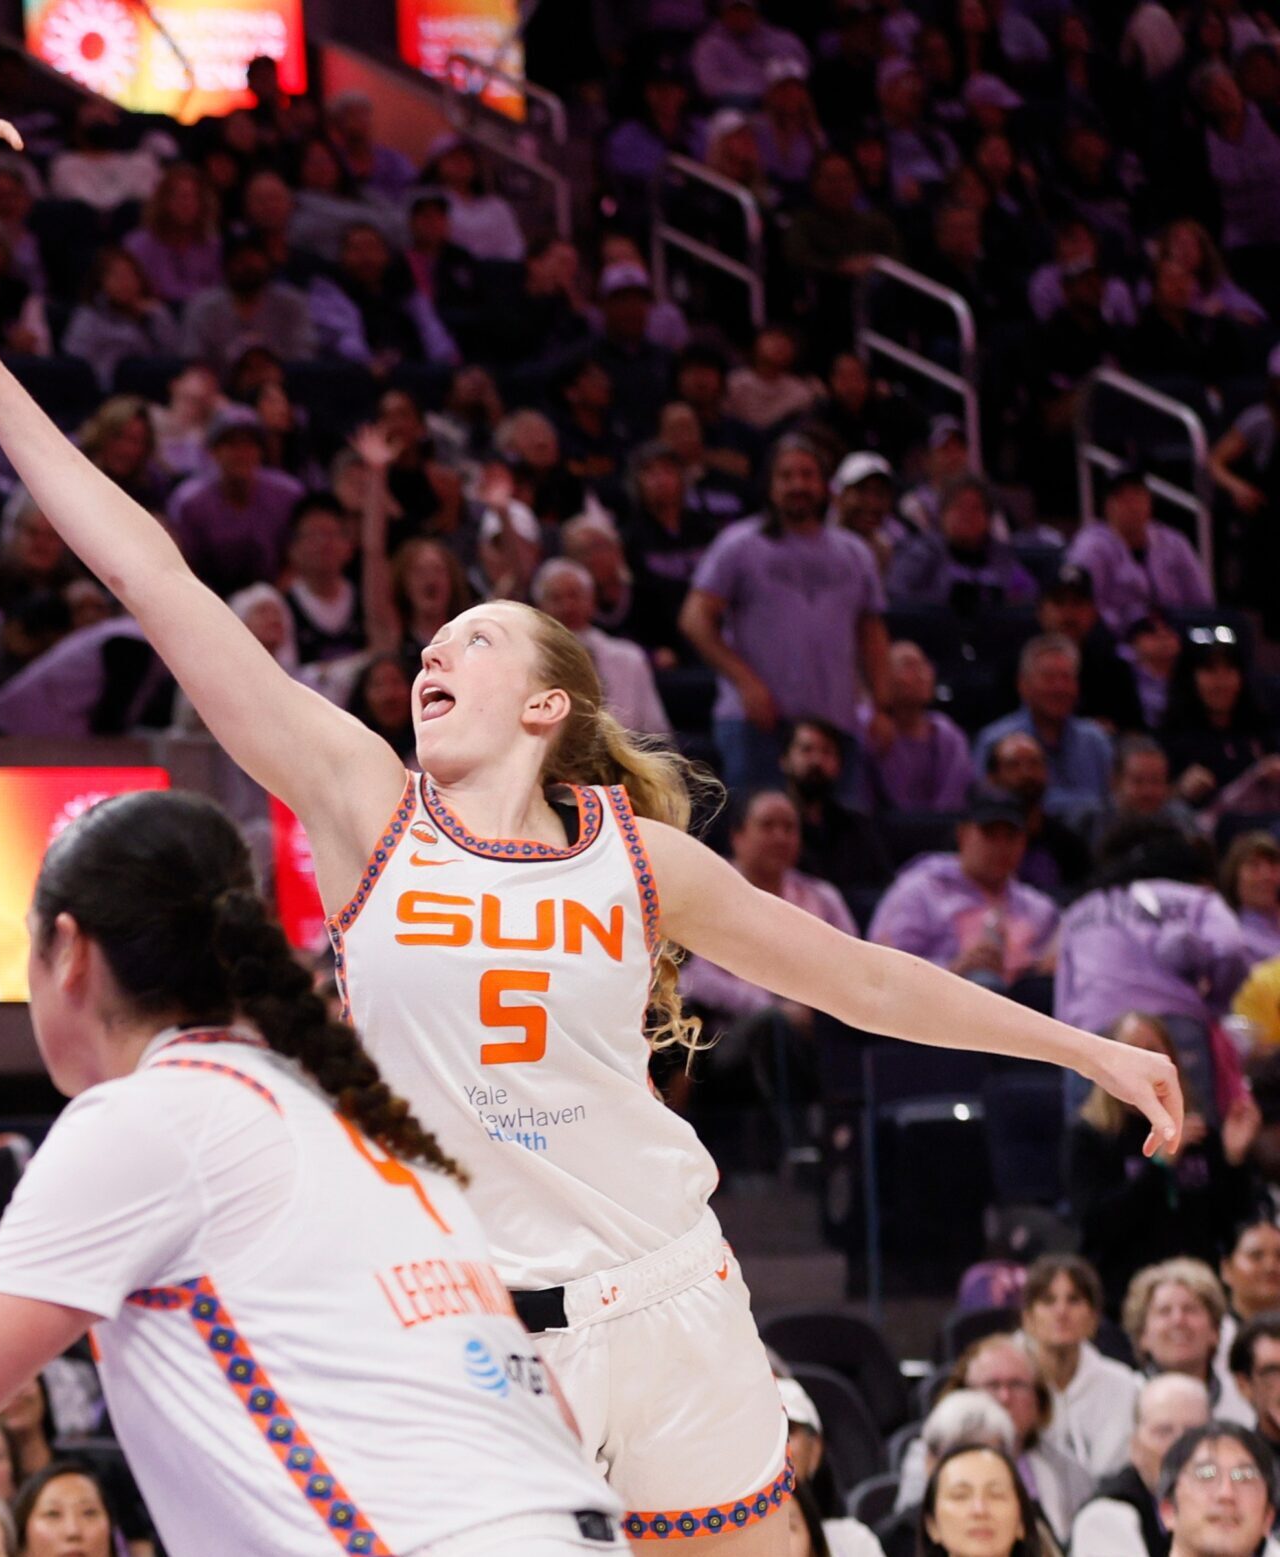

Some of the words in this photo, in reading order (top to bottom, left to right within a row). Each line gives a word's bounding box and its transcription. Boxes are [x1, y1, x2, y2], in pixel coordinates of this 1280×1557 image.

[394, 890, 624, 962] SUN
[479, 969, 551, 1065] 5
[463, 1085, 508, 1106] Yale
[485, 1126, 547, 1151] Hlth
